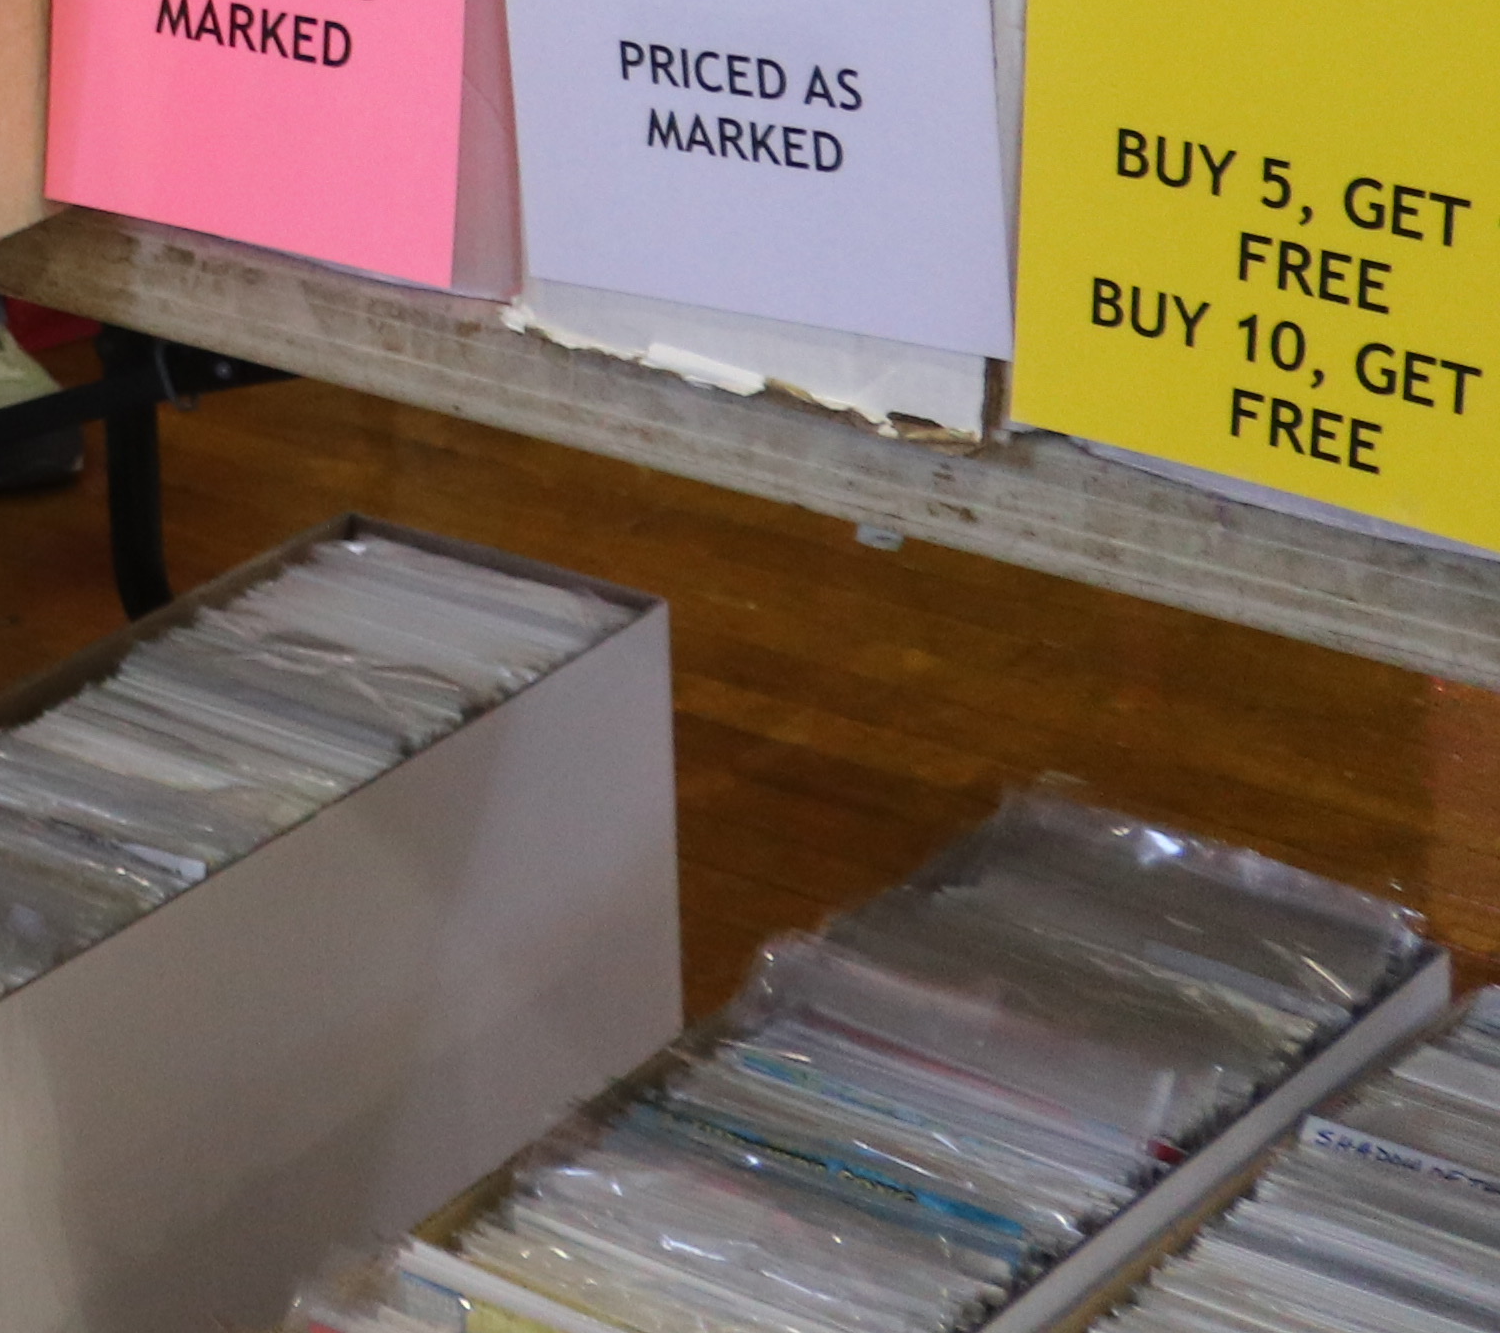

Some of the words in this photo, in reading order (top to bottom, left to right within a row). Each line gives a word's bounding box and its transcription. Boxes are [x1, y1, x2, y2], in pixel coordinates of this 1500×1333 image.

[618, 39, 788, 103] PRICED
[802, 65, 865, 113] AS
[646, 108, 843, 174] MARKED
[1114, 127, 1238, 199] BUY
[1259, 158, 1316, 229] 5,
[1341, 177, 1472, 251] GET
[1237, 231, 1393, 315] FREE
[1090, 277, 1212, 349] BUY
[1235, 312, 1328, 390] 10,
[1353, 342, 1483, 417] GET
[1227, 388, 1384, 475] FREE
